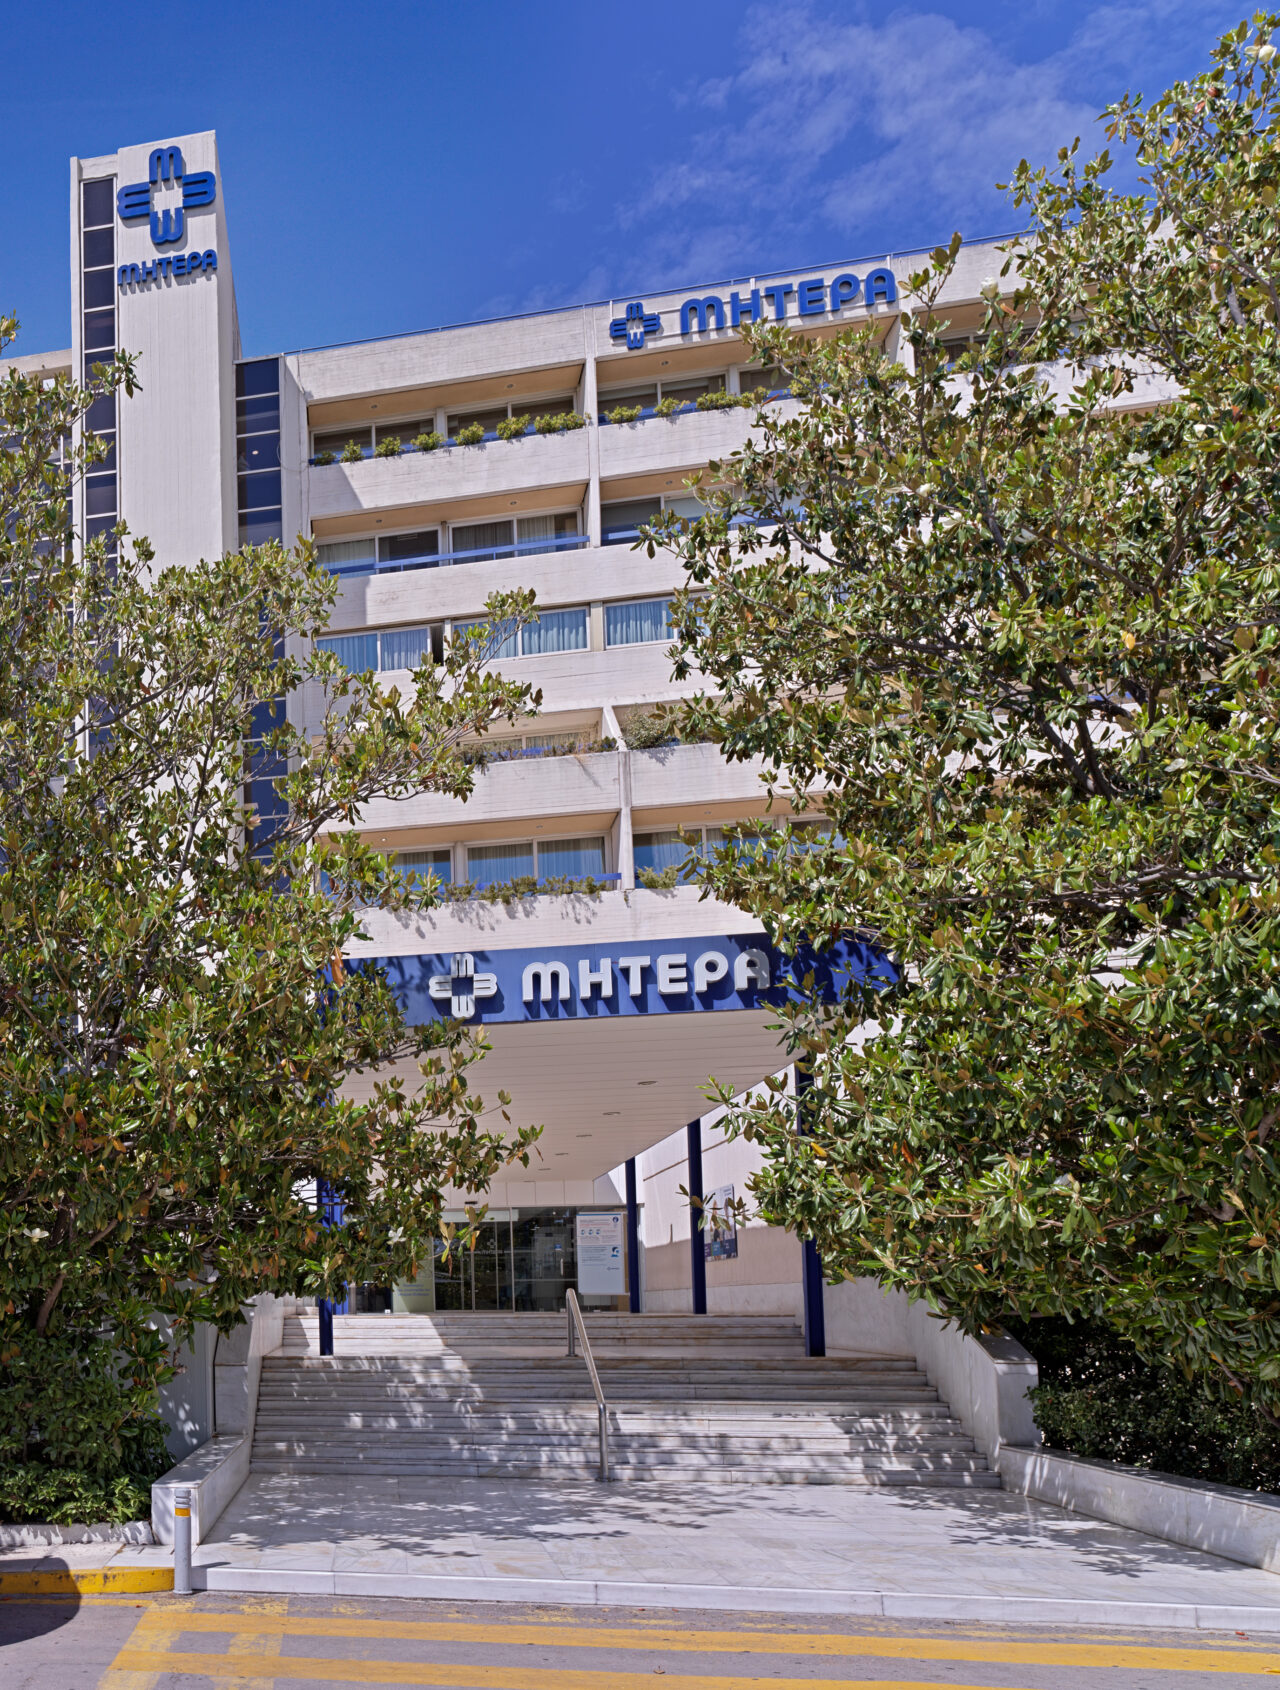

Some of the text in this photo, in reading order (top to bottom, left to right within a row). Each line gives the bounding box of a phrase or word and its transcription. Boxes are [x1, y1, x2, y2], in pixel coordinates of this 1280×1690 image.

[117, 249, 217, 286] ΜΗΤΕΡΑ
[680, 267, 896, 336] ΜΗΤΕΡΑ
[522, 949, 771, 1003] ΜΗΤΕΡΑ
